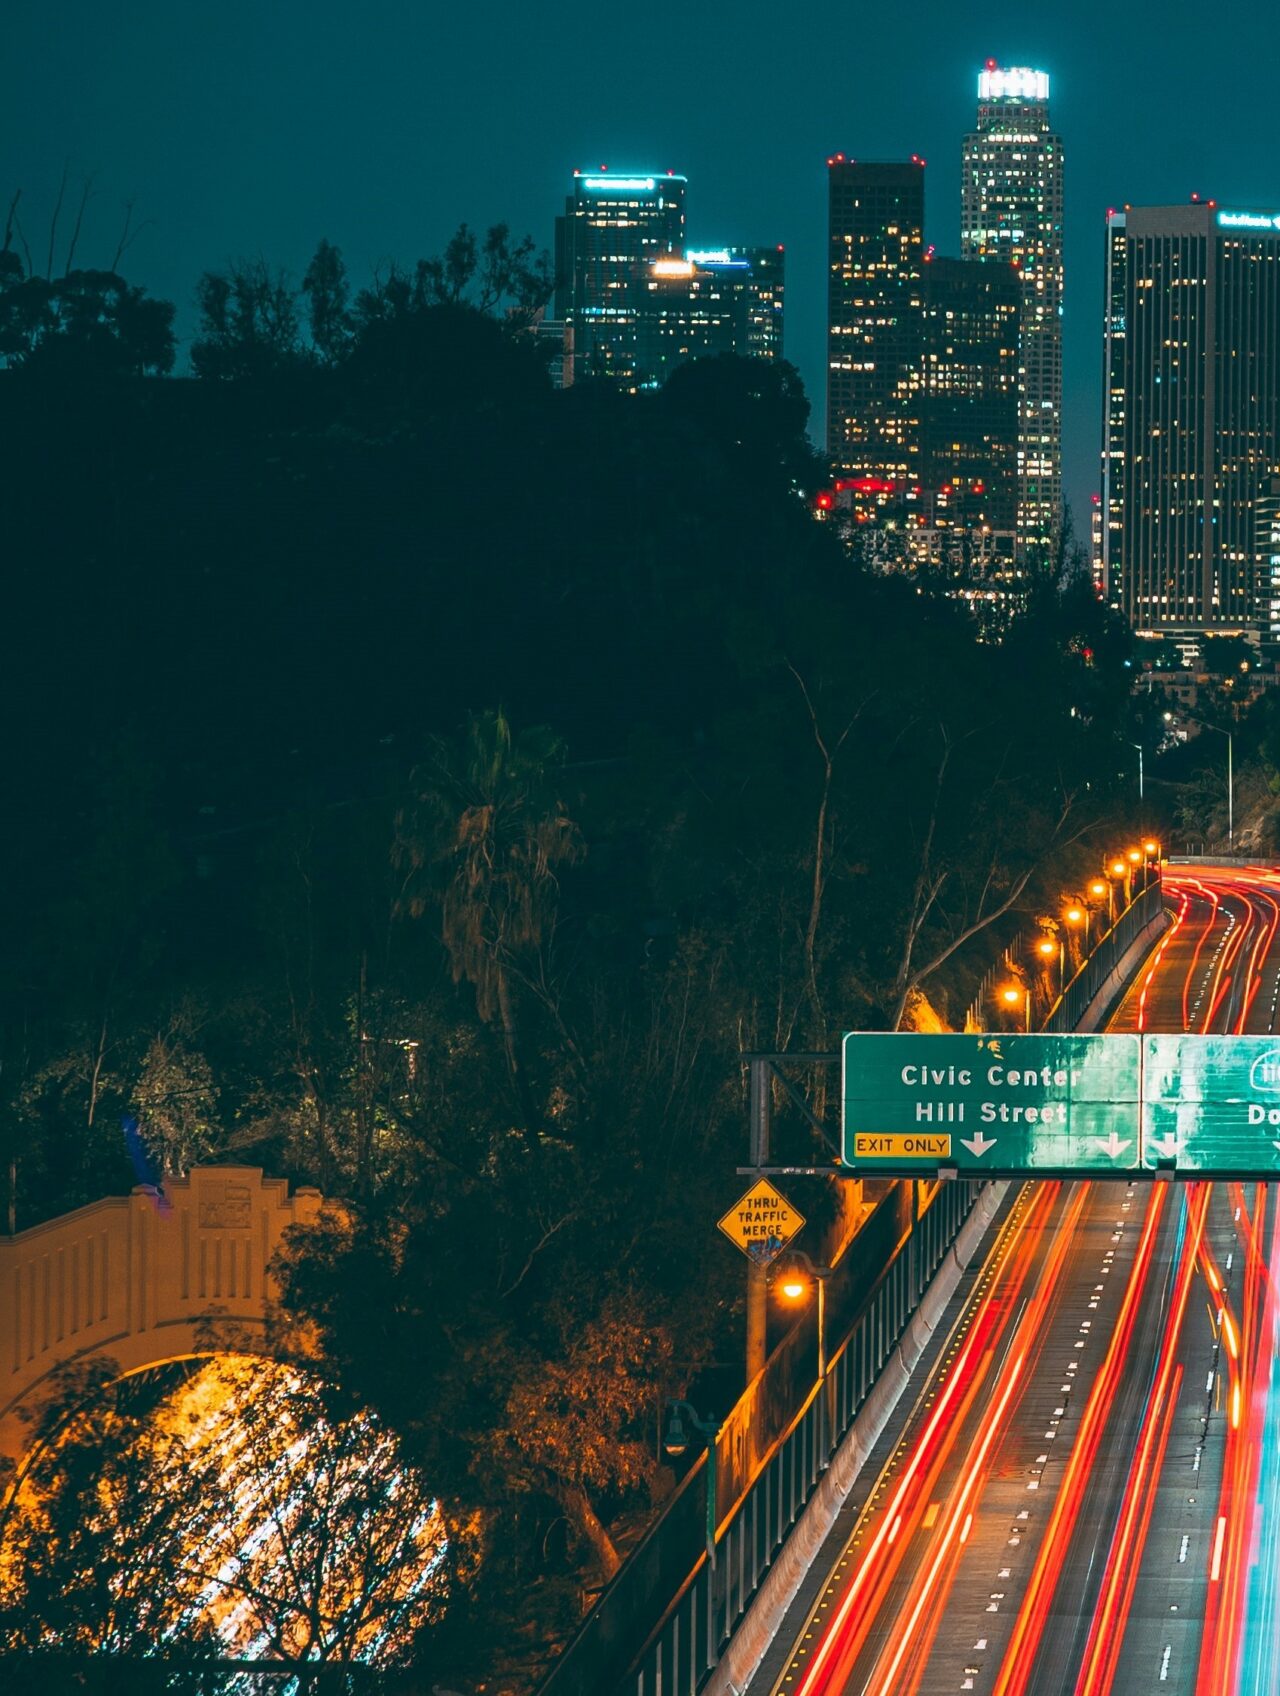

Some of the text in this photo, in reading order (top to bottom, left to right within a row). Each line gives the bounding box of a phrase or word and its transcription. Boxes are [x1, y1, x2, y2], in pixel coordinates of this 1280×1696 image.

[901, 1065, 1081, 1087] Civic Center
[915, 1102, 1067, 1123] Hill Street
[856, 1138, 948, 1153] EXIT ONLY
[747, 1197, 779, 1209] THRU
[738, 1211, 788, 1222] TRAFFIC
[743, 1224, 783, 1236] MERGE
